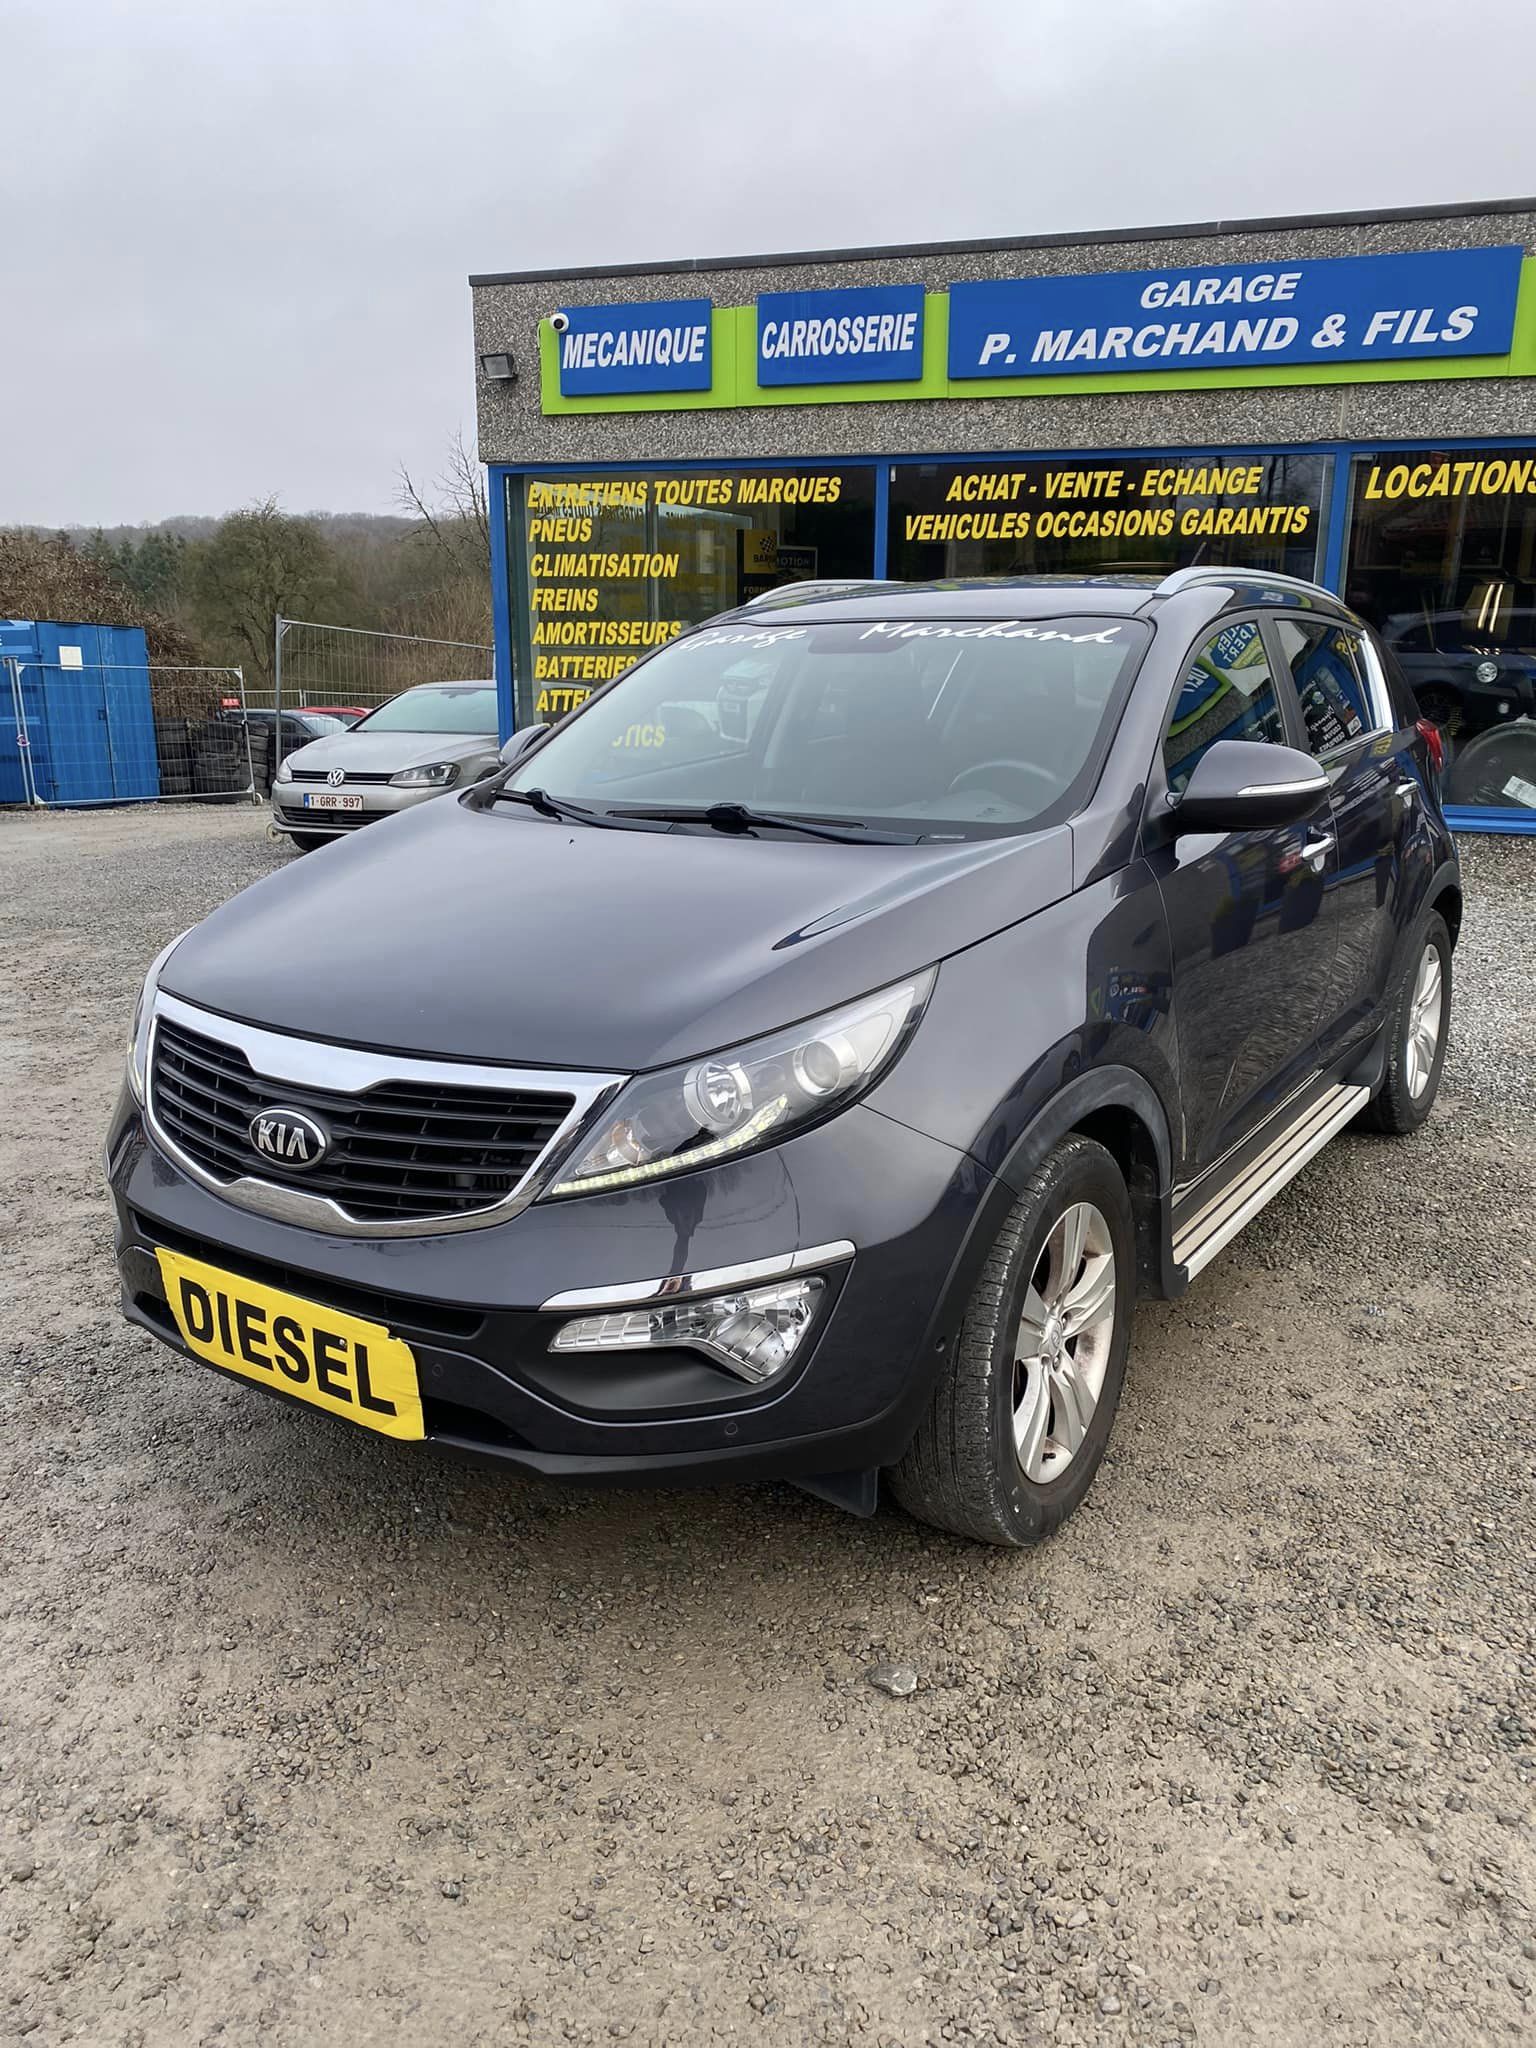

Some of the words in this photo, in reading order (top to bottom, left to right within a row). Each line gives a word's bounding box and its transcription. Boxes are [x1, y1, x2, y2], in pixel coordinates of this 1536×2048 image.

[1139, 272, 1302, 309] GARAGE
[562, 325, 707, 369] MECANIQUE
[761, 313, 918, 359] CARROSSERIE
[978, 333, 1017, 365] P.
[1030, 317, 1299, 363] MARCHAND
[1311, 313, 1346, 348] &
[1362, 306, 1479, 346] FILS
[527, 481, 648, 509] ENTRETIENS
[654, 478, 733, 506] TOUTES
[737, 476, 842, 504] MARQUES
[945, 473, 1026, 502] ACHAT
[1045, 470, 1124, 499] VENTE
[1140, 466, 1264, 497] ECHANGE
[528, 517, 593, 543] PNEUS
[905, 512, 1031, 541] VEHICULES
[1035, 508, 1175, 538] OCCASIONS
[1180, 505, 1310, 536] GARANTIS
[530, 553, 680, 578] CLIMATISATION
[530, 588, 599, 612] FREINS
[532, 620, 682, 645] AMORTISSEURS
[858, 620, 1122, 644] Marchand
[536, 689, 591, 712] ATTE
[256, 1119, 309, 1161] KIA
[178, 1276, 398, 1417] DIESEL
